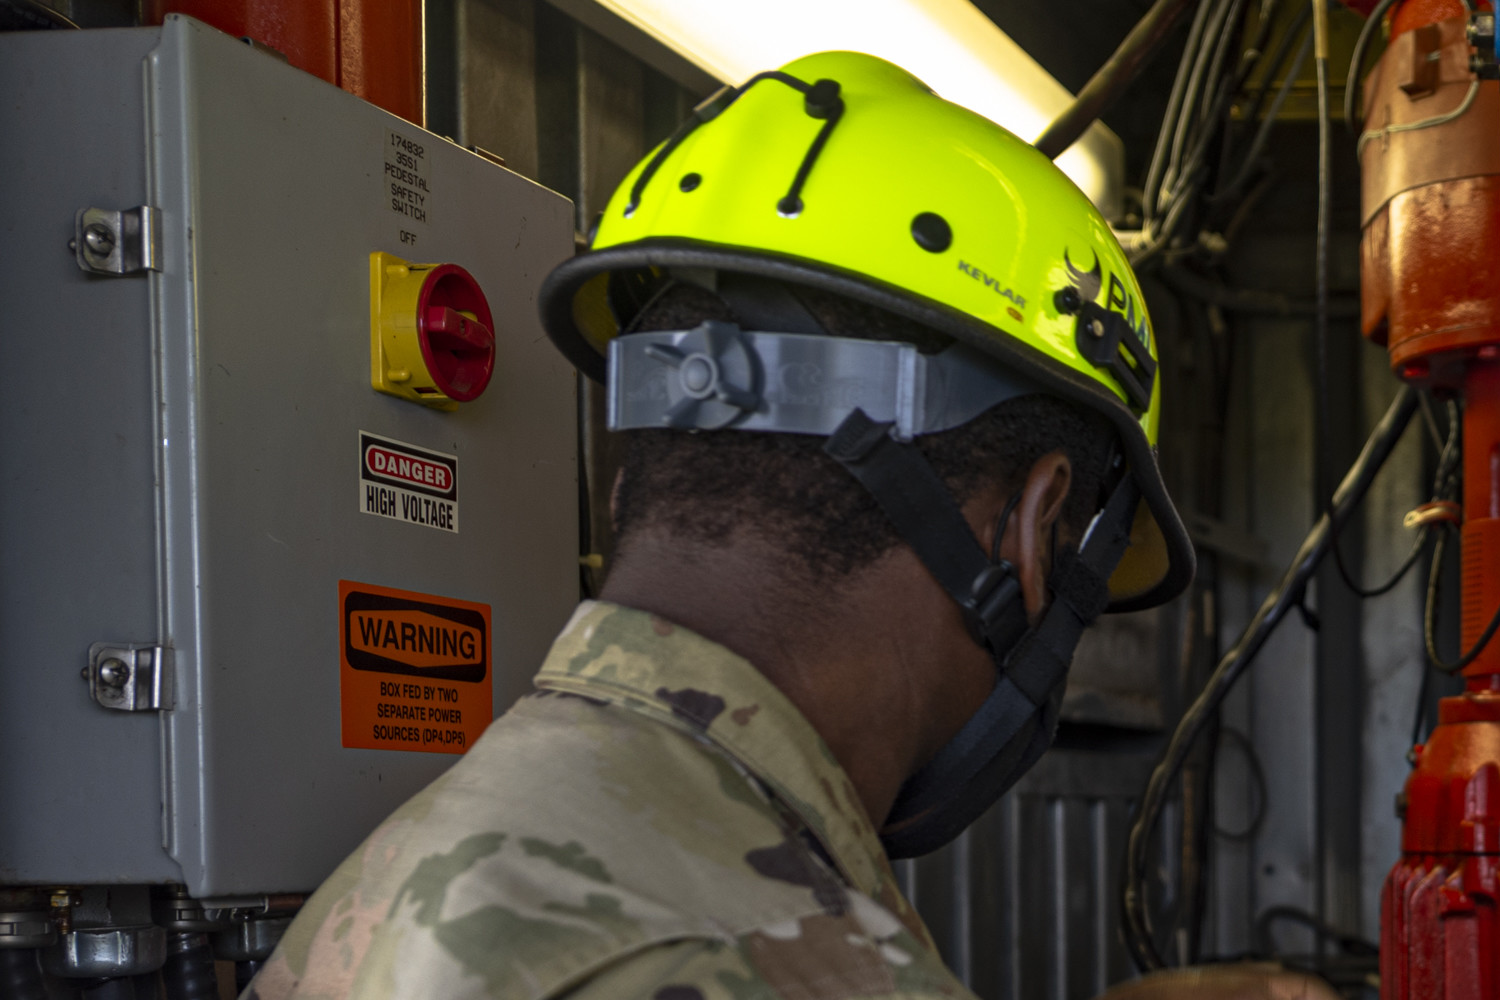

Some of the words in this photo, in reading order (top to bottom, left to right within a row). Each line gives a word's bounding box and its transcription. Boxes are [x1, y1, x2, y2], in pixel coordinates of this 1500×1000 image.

[391, 133, 424, 159] 174832
[385, 162, 430, 193] PEDESTAL
[391, 183, 425, 206] SAFETY
[392, 198, 426, 222] SWITCH
[400, 230, 417, 246] OFF
[957, 259, 1027, 309] KEVLAR
[374, 451, 446, 487] DANGER
[366, 485, 397, 516] HIGH
[402, 493, 453, 530] VOLTAGE
[358, 616, 476, 661] WARNING
[380, 681, 401, 697] BOX
[403, 683, 422, 699] FED
[424, 686, 436, 701] BY
[438, 687, 459, 702] TWO
[377, 702, 427, 721] SEPARATE
[428, 707, 461, 724] POWER
[373, 724, 420, 741] SOURCES
[423, 728, 466, 748] (DP4,DP5)
